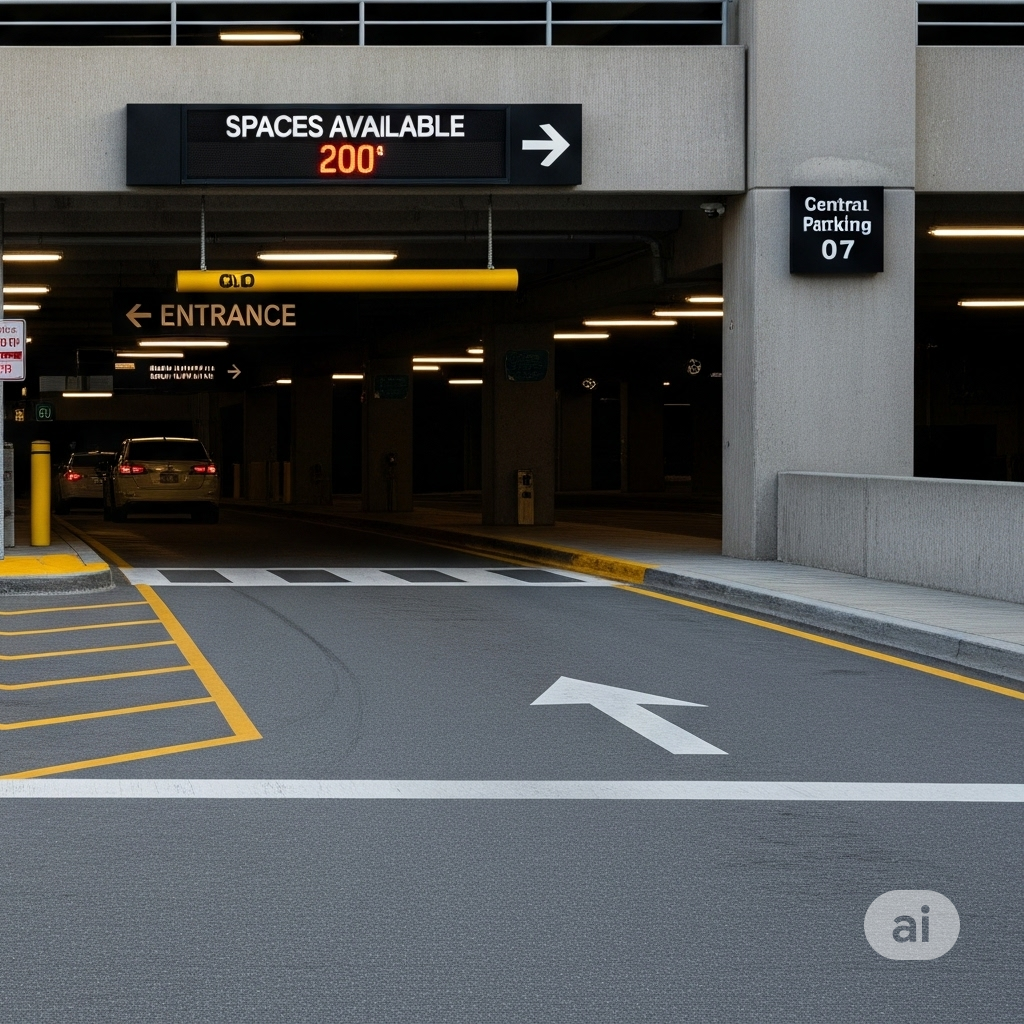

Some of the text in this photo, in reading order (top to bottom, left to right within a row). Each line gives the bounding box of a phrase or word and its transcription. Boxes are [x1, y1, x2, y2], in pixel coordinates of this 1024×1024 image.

[226, 114, 465, 138] SPACES AVAILABLE
[804, 196, 870, 212] Central
[821, 239, 855, 260] 07
[161, 303, 297, 327] ENTRANCE
